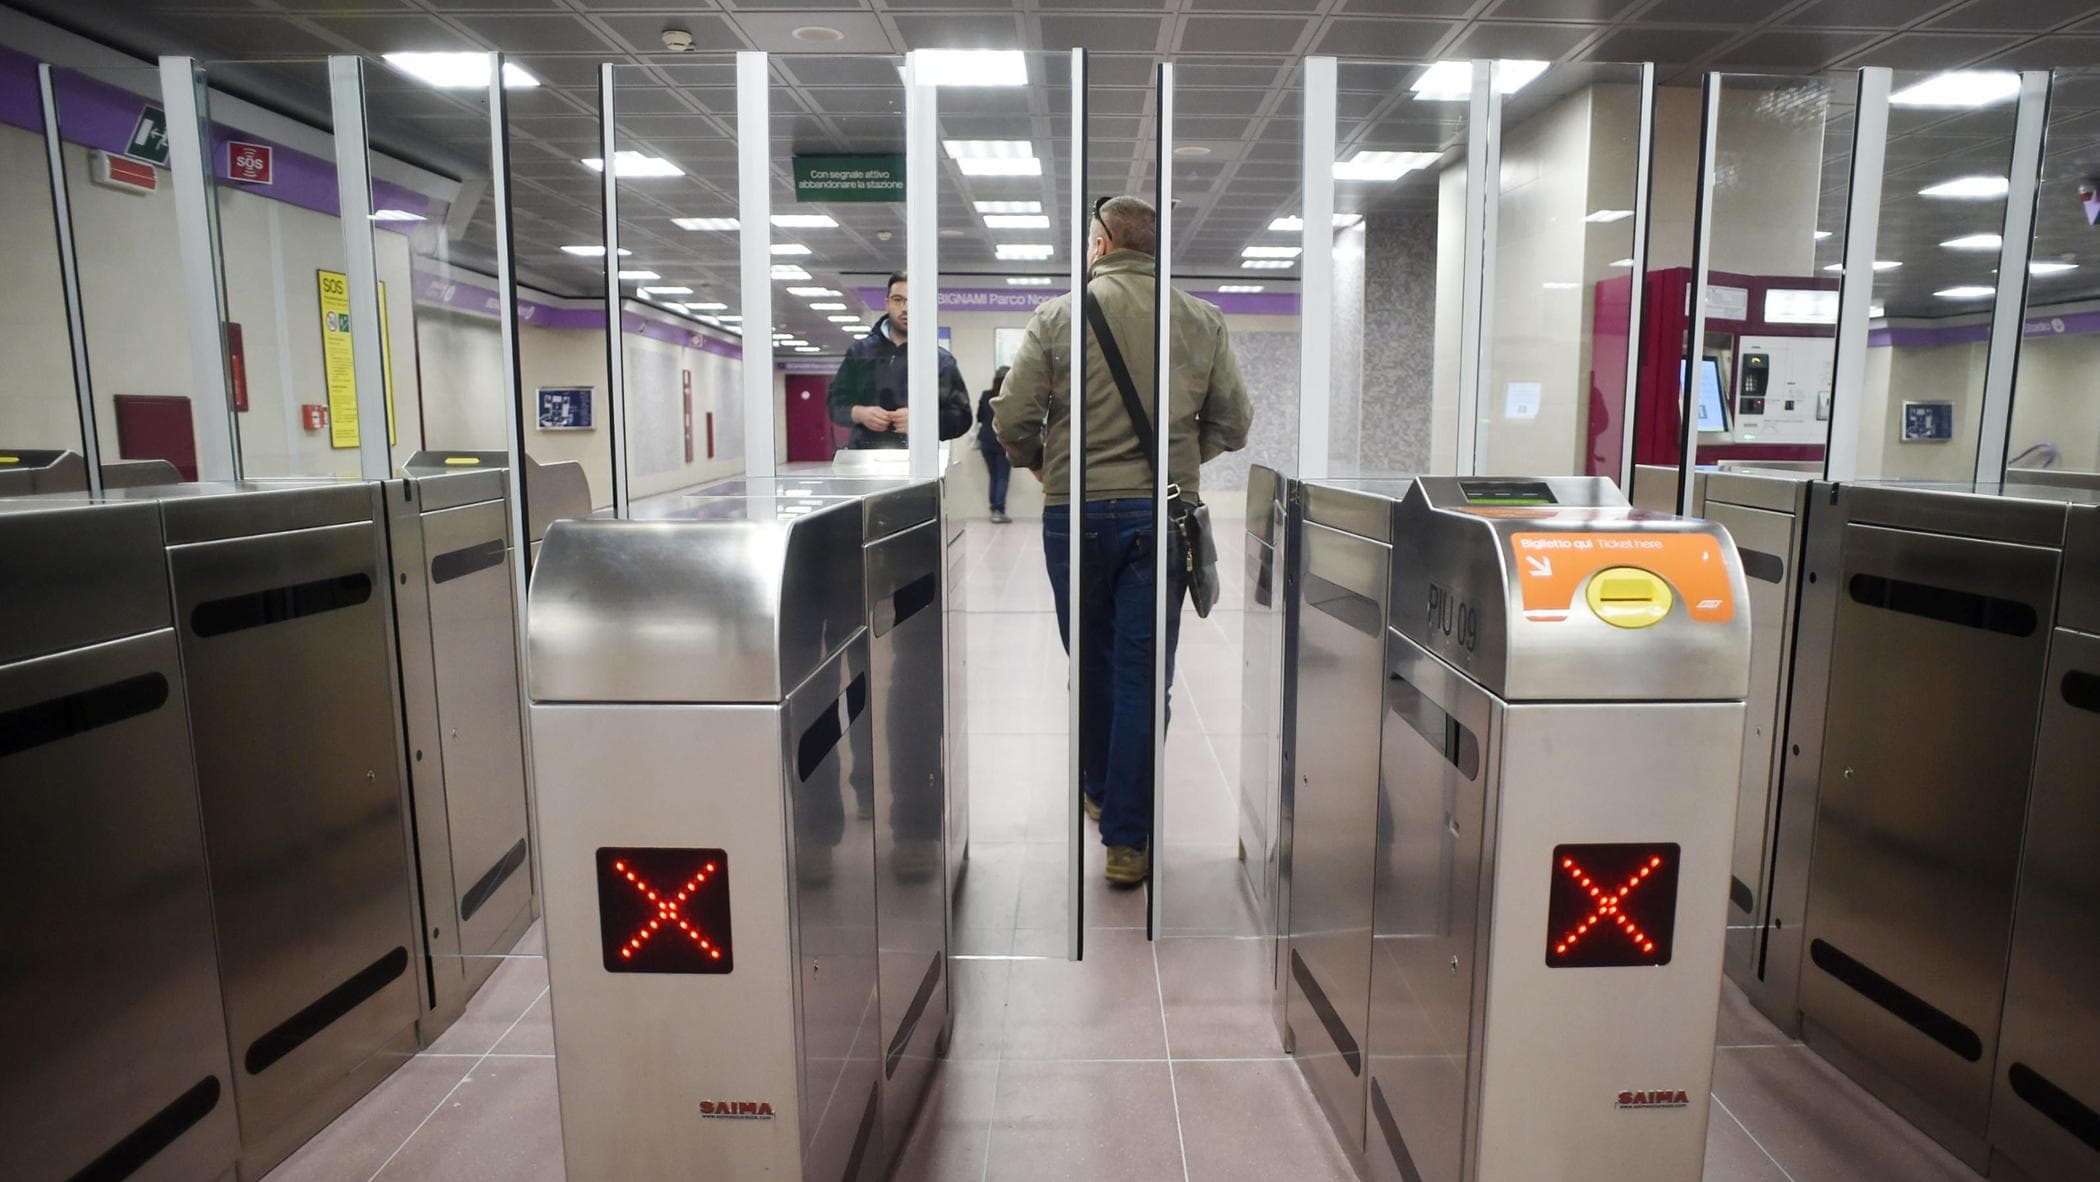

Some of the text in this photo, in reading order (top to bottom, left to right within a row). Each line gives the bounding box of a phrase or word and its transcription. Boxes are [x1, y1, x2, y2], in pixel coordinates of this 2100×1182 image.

[236, 156, 264, 170] SOS
[810, 170, 890, 180] Con segnale attivo
[799, 180, 904, 189] abbandonare la stazione
[322, 278, 344, 295] SOS
[937, 293, 987, 305] BIGNAMI
[989, 293, 1024, 305] Parco
[1520, 538, 1663, 550] Biglietto qui Ticket here
[1457, 602, 1477, 653] 09
[1618, 1091, 1689, 1104] SAIMA
[699, 1101, 774, 1116] SAIMA
